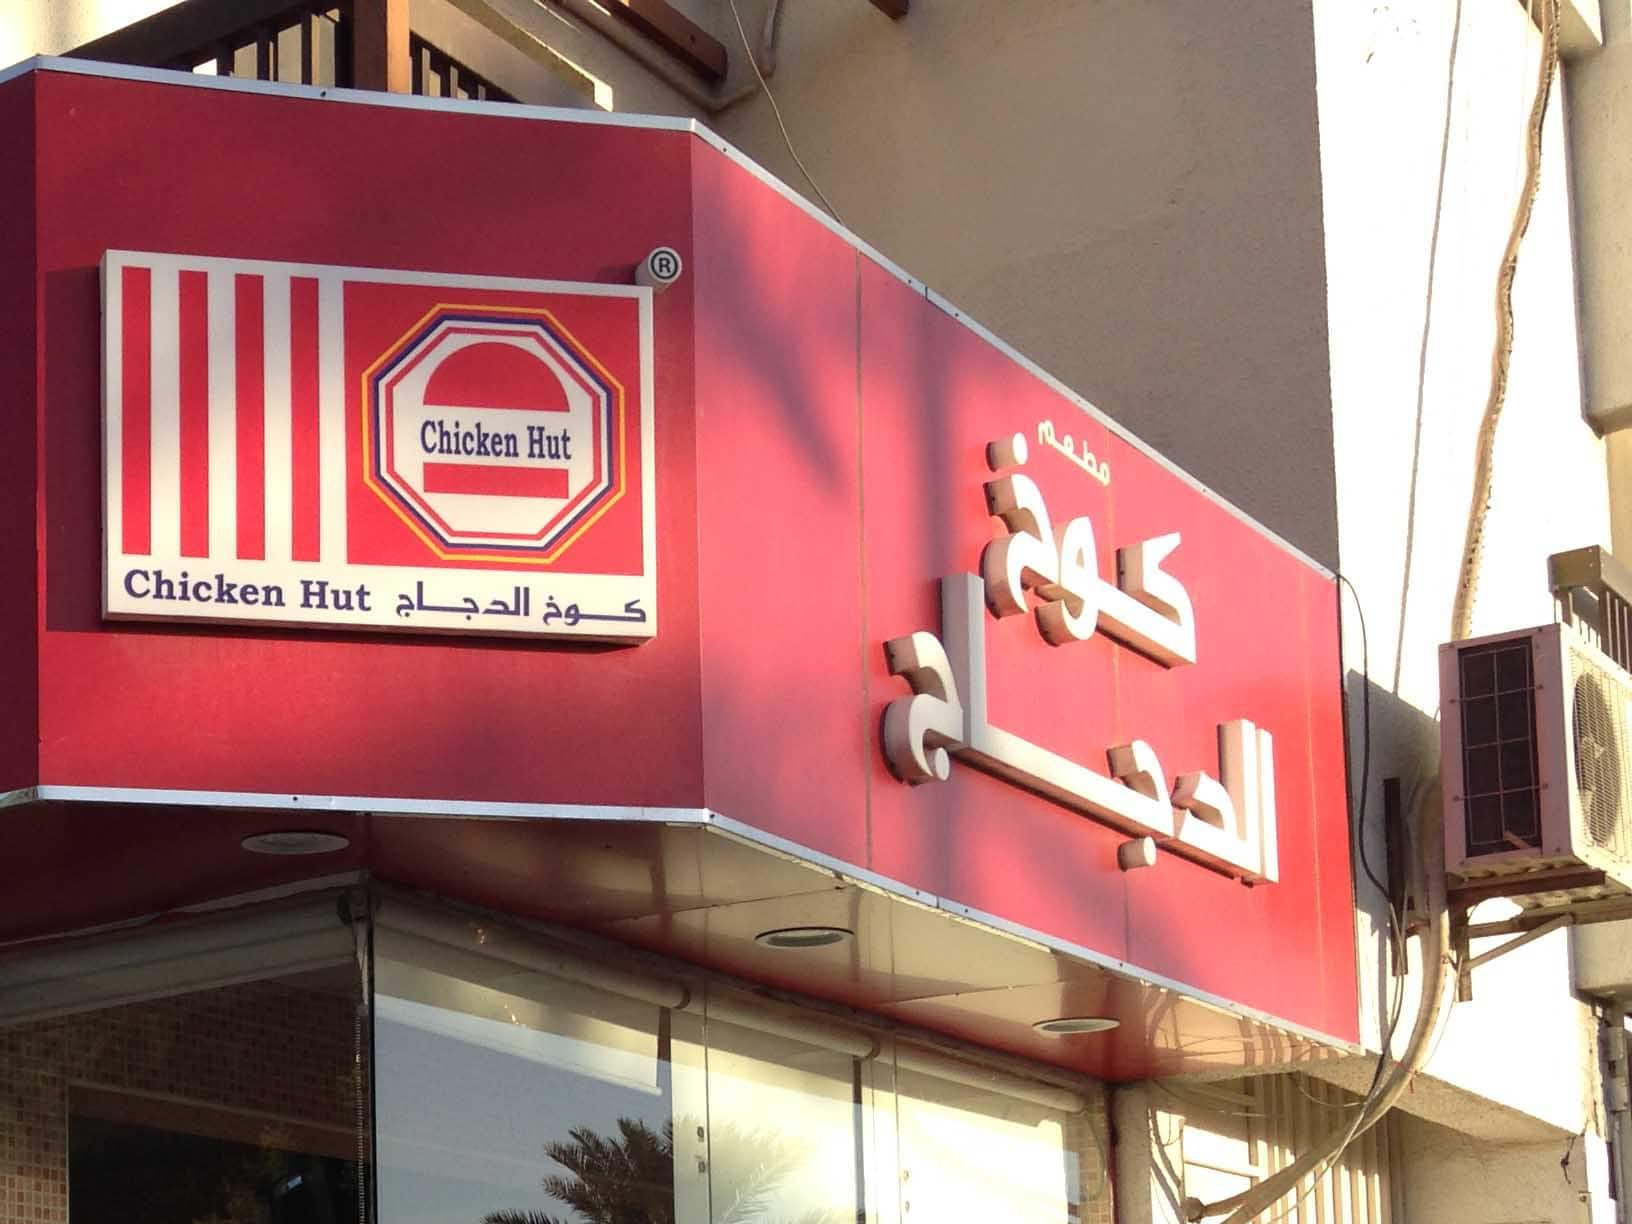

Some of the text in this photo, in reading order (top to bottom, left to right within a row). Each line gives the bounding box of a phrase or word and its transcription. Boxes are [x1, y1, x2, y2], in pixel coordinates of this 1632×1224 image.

[420, 418, 572, 461] Chicken Hut
[1037, 419, 1110, 487] مطعم
[980, 431, 1196, 671] كوخ
[123, 568, 372, 612] Chicken Hut
[395, 581, 647, 626] كوخ الدجاج
[880, 571, 1279, 886] الدجاج
